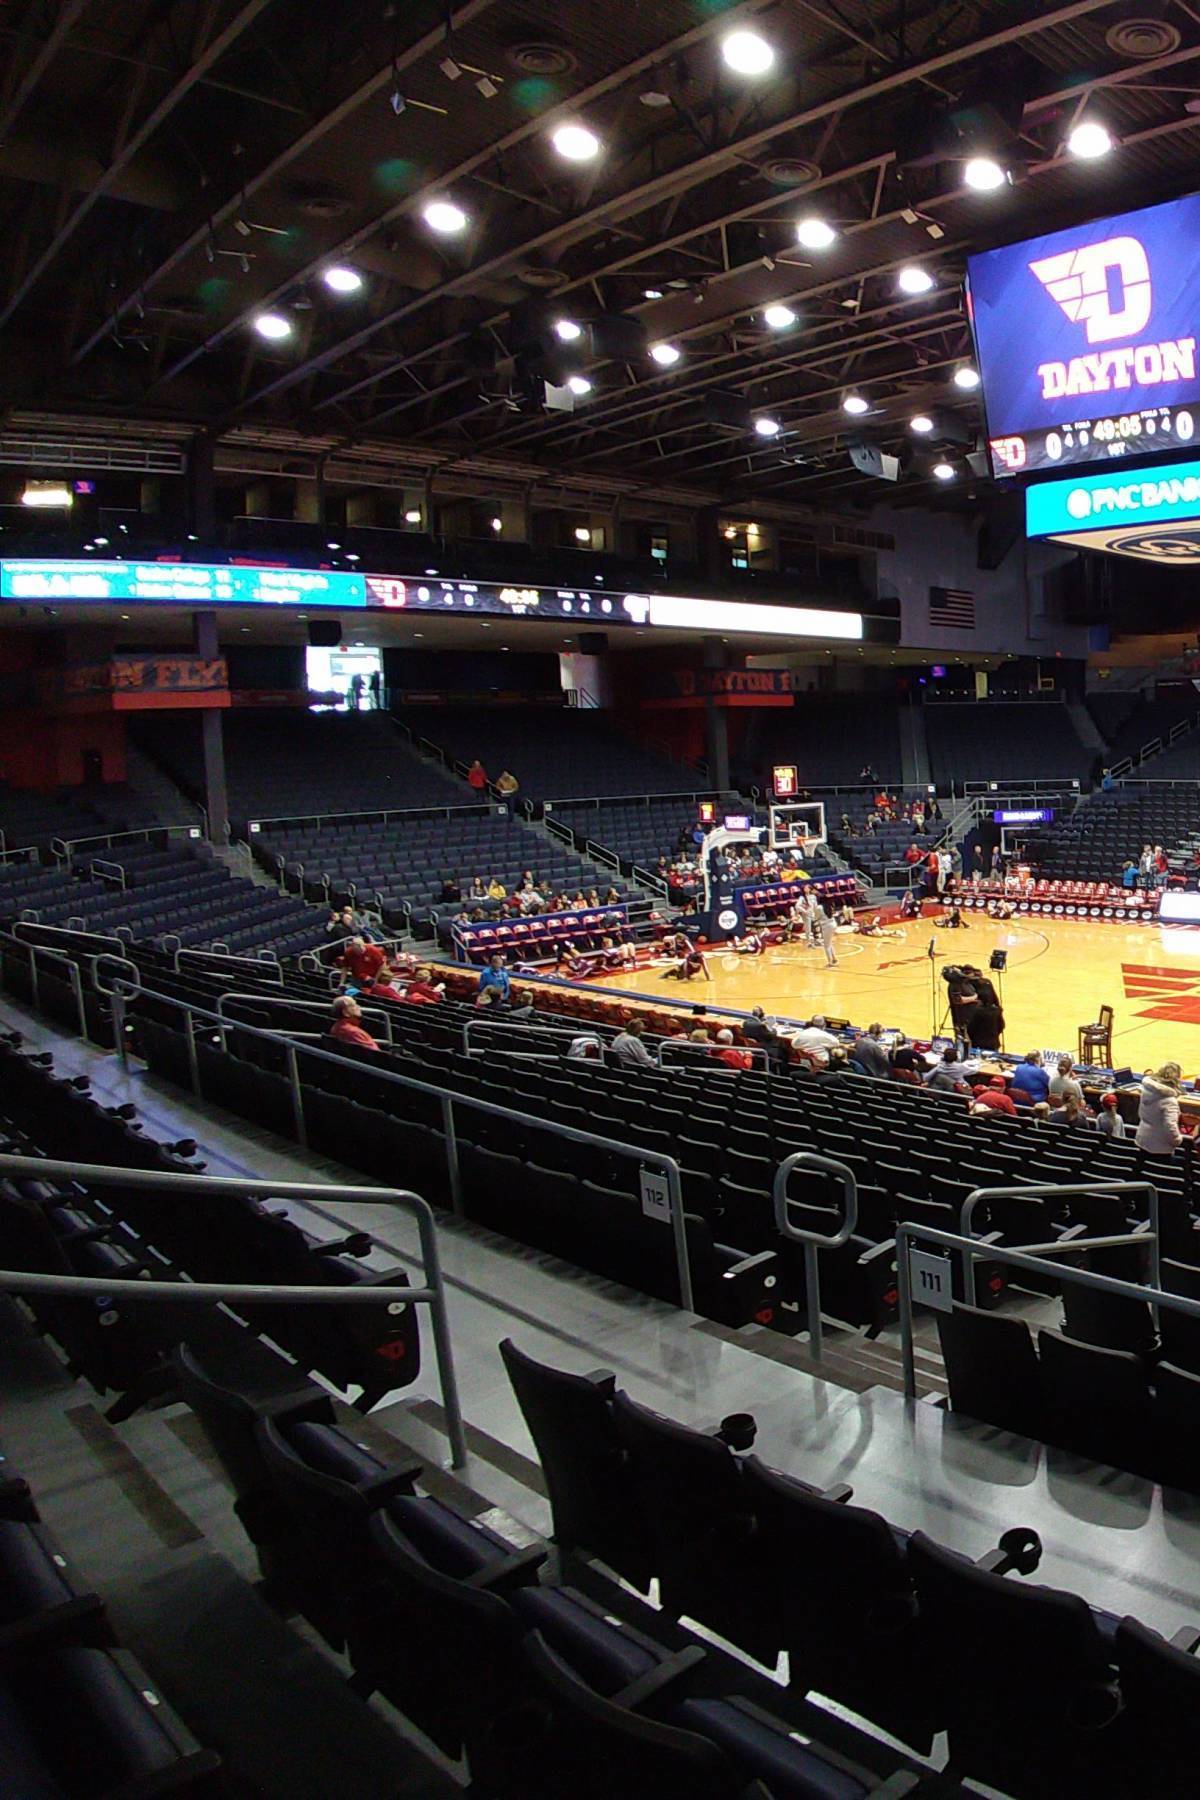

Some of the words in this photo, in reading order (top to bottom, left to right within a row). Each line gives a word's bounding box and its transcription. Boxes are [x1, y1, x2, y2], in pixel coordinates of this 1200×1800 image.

[1028, 236, 1152, 343] D
[1038, 336, 1196, 400] DAYTON
[1176, 410, 1194, 440] 0
[1046, 433, 1062, 460] 0
[645, 1188, 665, 1207] 112
[920, 1270, 941, 1292] 111
